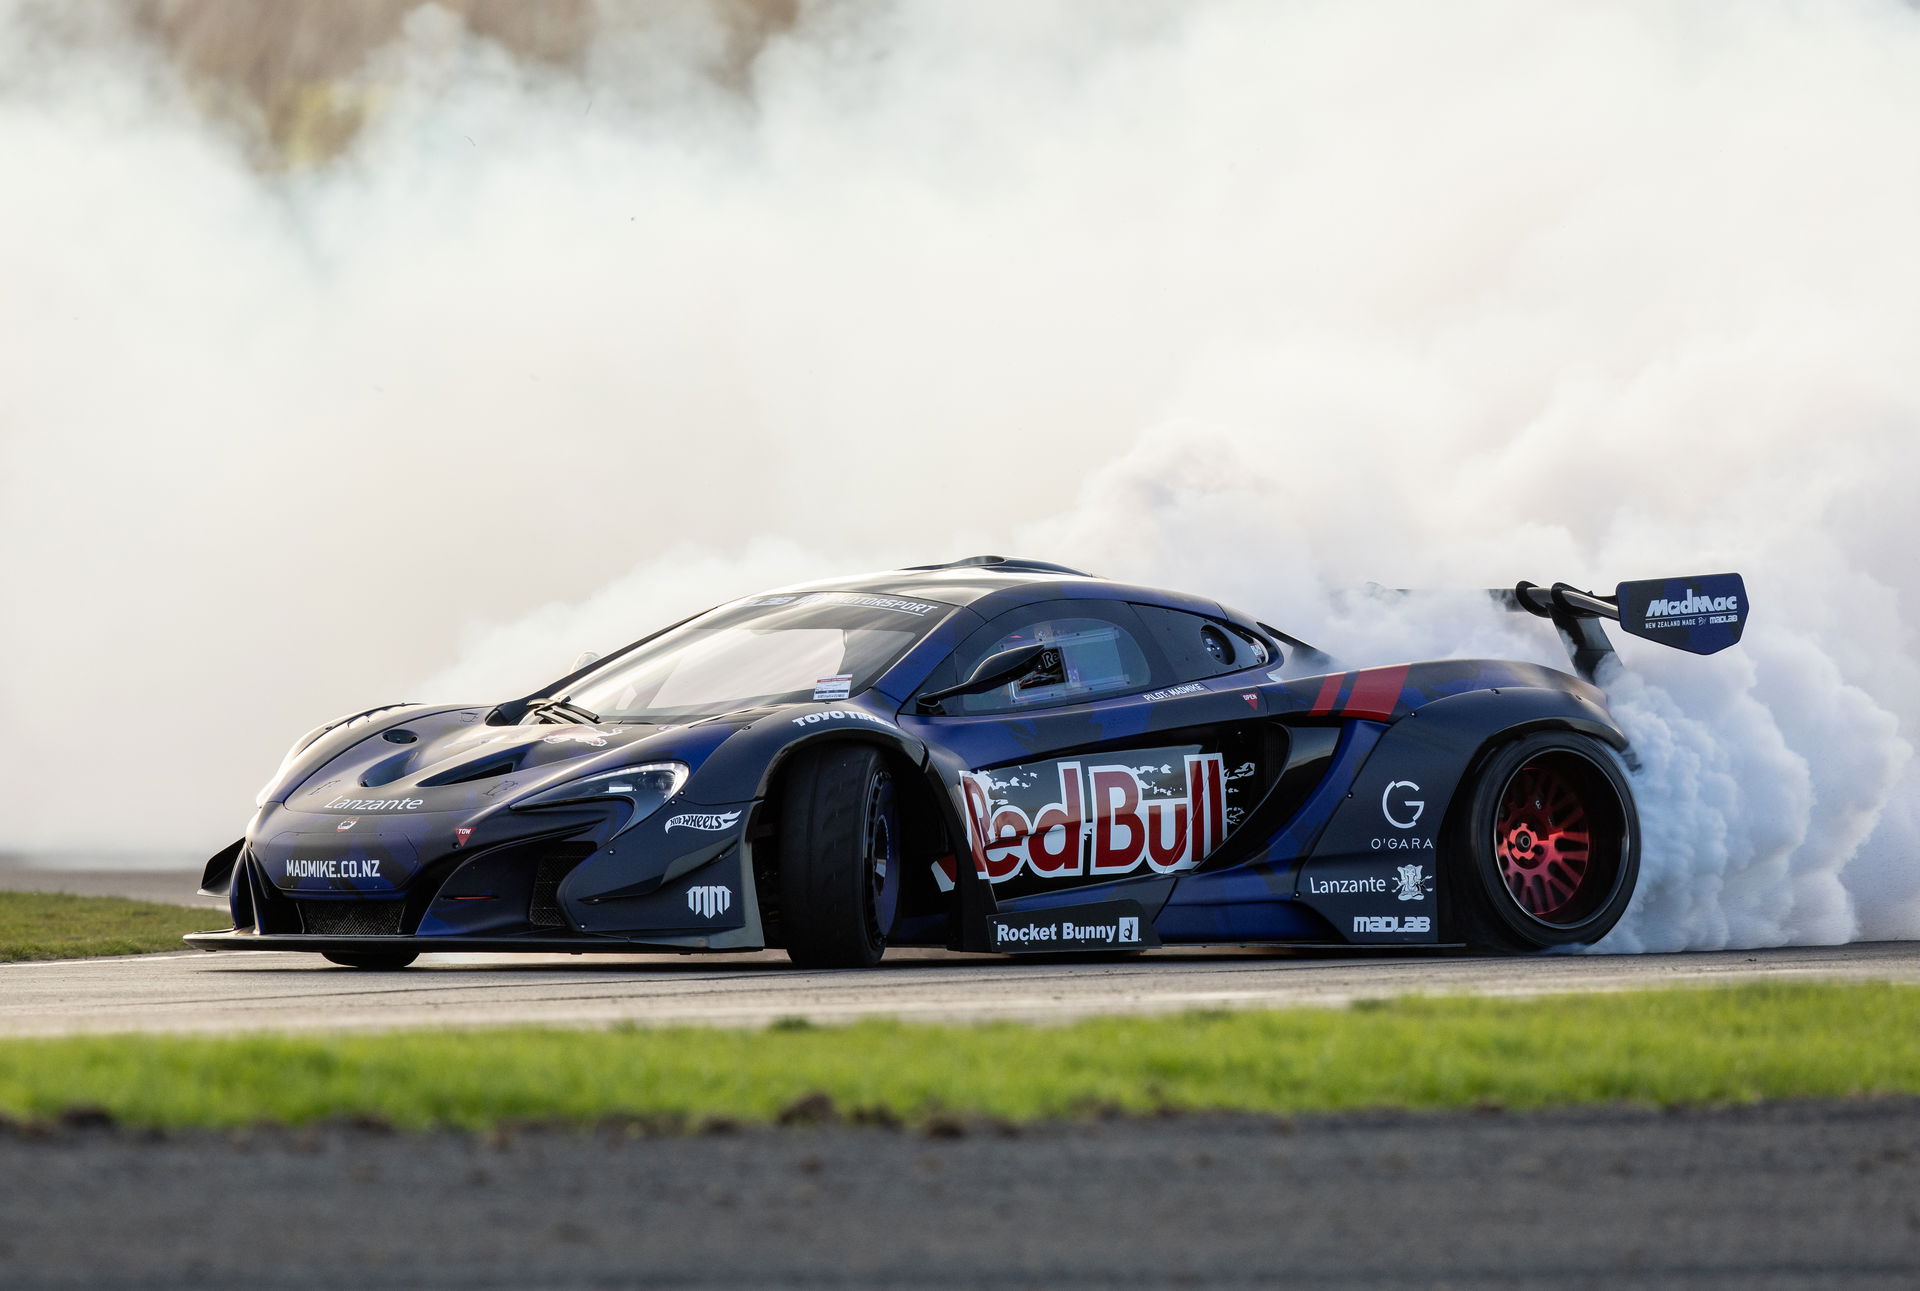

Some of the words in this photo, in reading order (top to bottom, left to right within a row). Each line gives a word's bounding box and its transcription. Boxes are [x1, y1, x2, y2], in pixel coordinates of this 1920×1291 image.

[1657, 619, 1680, 628] ZEALAND
[1681, 618, 1696, 626] MADE
[1168, 683, 1204, 698] MADMIKE
[792, 711, 845, 726] TOYO
[323, 795, 424, 810] Lanzante
[958, 761, 1085, 884] Red
[1087, 753, 1227, 875] Bull
[1371, 838, 1434, 850] O'GARA
[286, 859, 381, 878] MADMIKE.CO.NZ
[1310, 877, 1387, 894] Lanzante
[997, 923, 1057, 942] Rocket
[1062, 922, 1117, 943] Bunny
